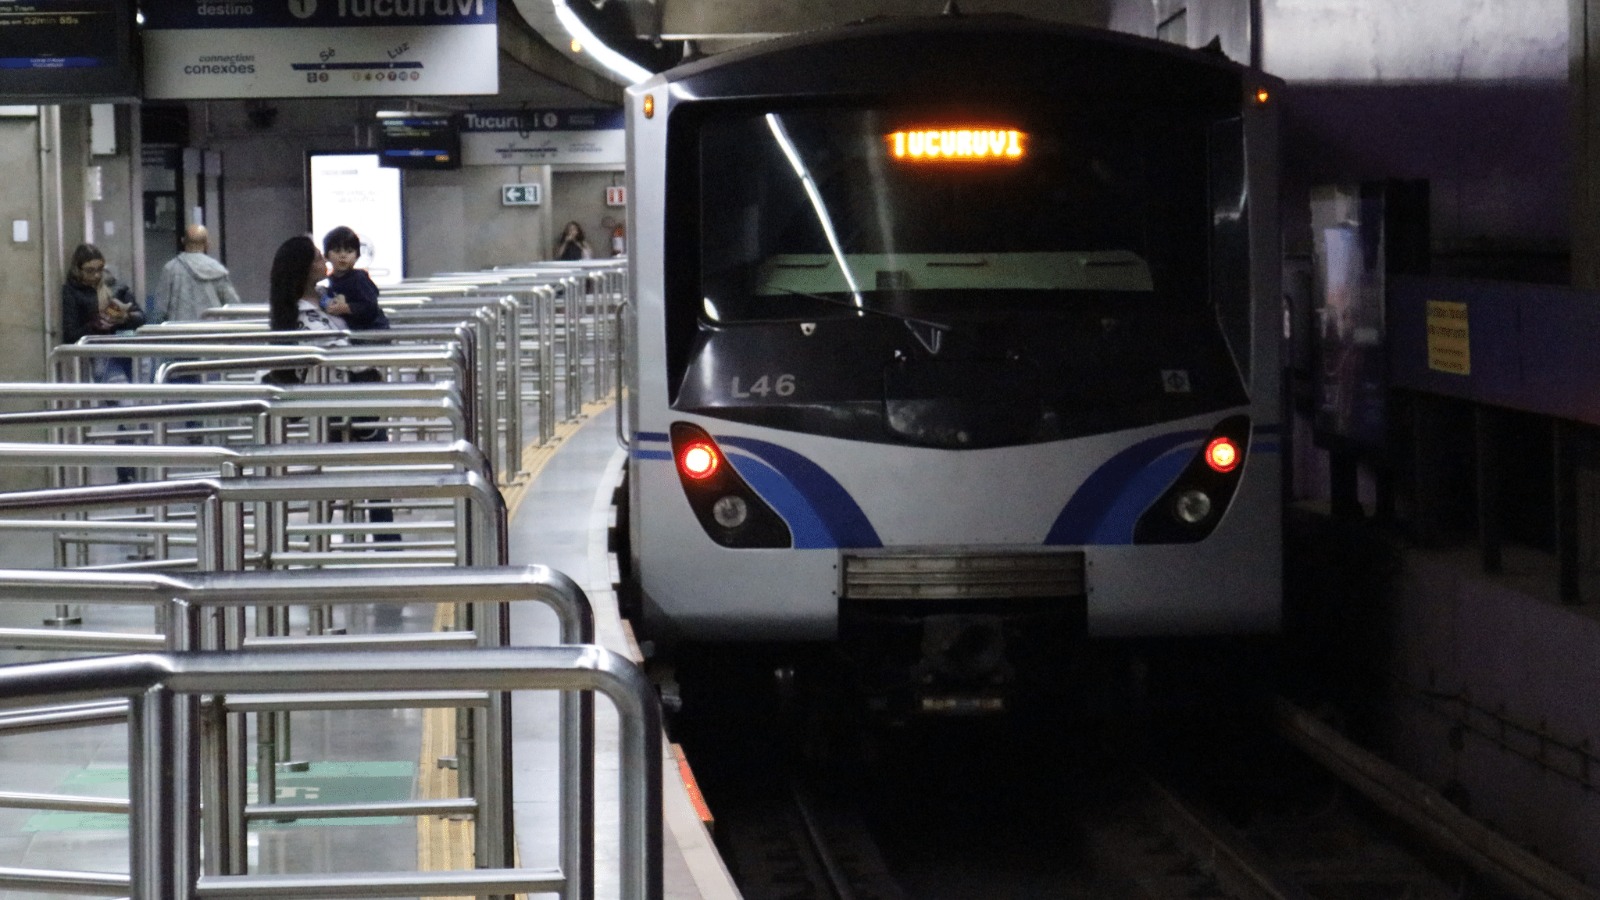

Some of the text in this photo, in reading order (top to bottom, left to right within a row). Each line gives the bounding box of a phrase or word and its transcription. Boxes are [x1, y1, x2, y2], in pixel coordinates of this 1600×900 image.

[197, 4, 253, 16] destino
[338, 0, 484, 17] Tucuruvi
[199, 53, 255, 62] connection
[387, 42, 409, 59] Luz
[184, 61, 255, 74] conexões
[465, 113, 538, 128] Tucuri
[731, 372, 795, 398] L46
